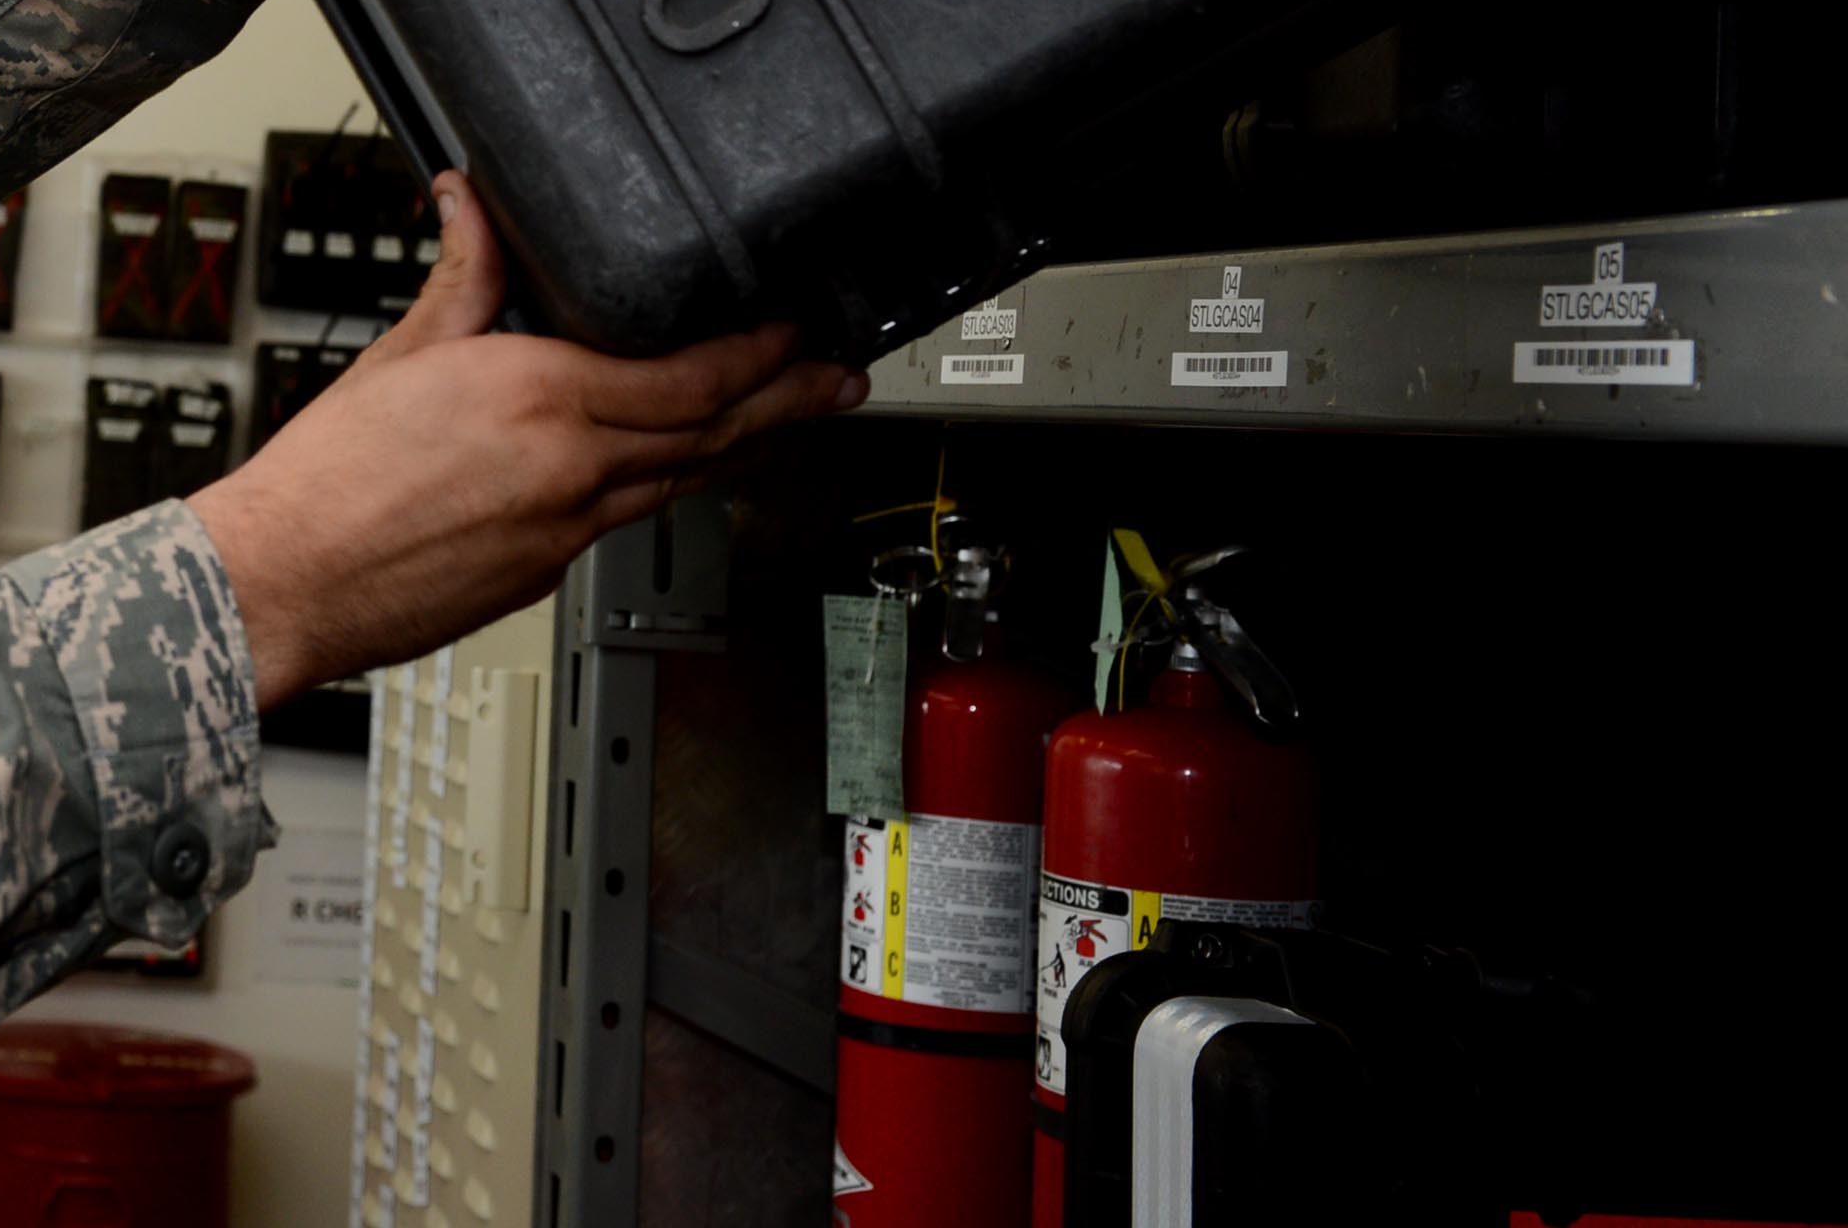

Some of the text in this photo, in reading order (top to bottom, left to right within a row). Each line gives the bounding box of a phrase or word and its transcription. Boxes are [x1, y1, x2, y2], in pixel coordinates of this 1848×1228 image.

[1598, 250, 1620, 280] 05
[1223, 272, 1239, 295] 04
[1191, 304, 1261, 328] STLGCAS04
[1543, 290, 1651, 321] STLGCAS05
[963, 314, 1015, 336] STLGCAS03
[891, 830, 903, 857] A
[890, 890, 901, 917] B
[1138, 914, 1153, 944] A
[887, 950, 899, 977] C
